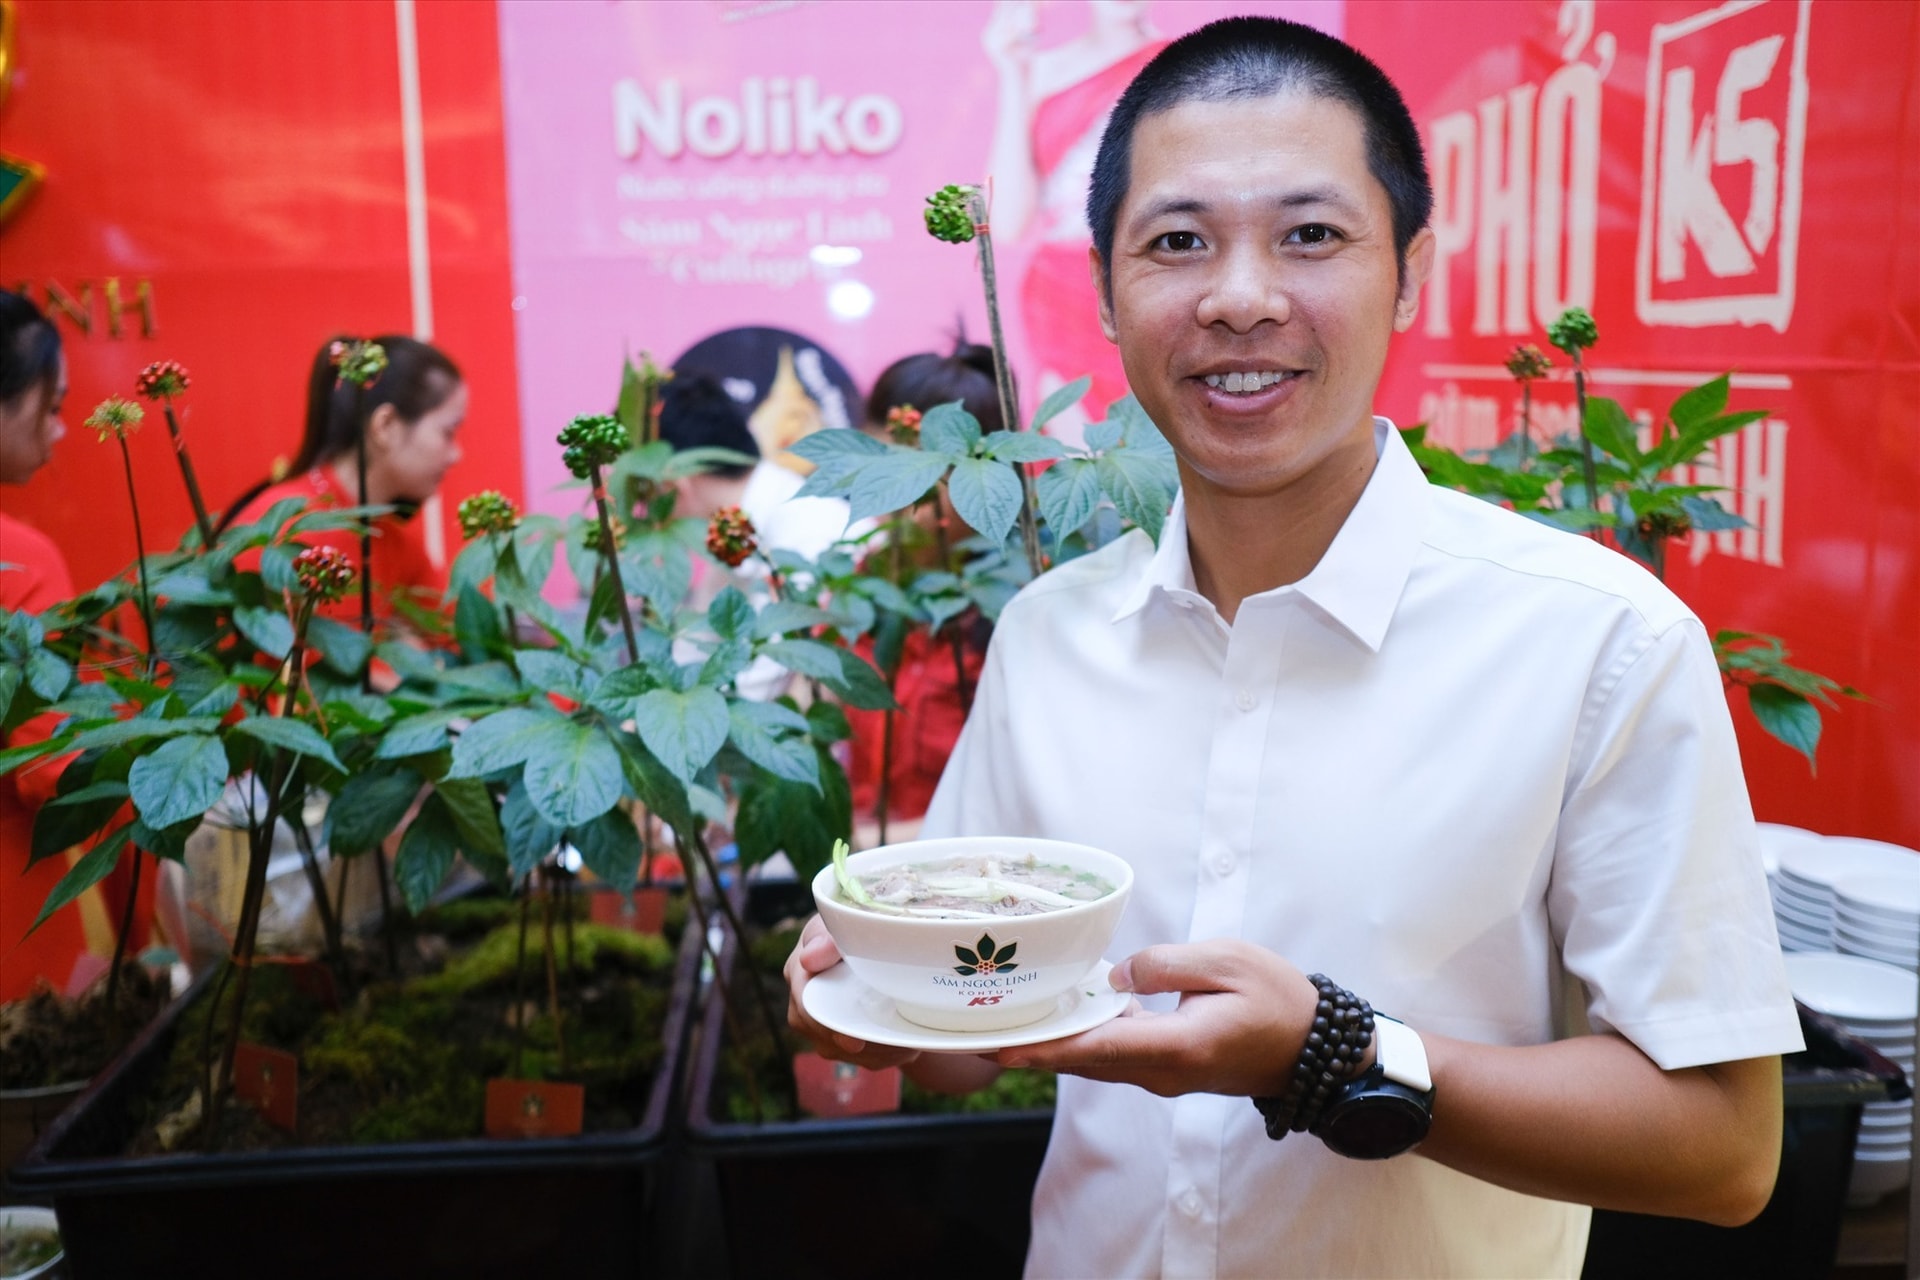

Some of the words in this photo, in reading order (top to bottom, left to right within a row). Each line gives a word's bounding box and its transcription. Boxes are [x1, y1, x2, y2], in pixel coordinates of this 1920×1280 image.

[612, 77, 902, 158] Noliko
[1423, 0, 1617, 338] PHỞ
[1657, 34, 1785, 283] K5
[14, 277, 158, 341] NH
[967, 995, 1004, 1007] K5
[1006, 971, 1037, 986] LINH
